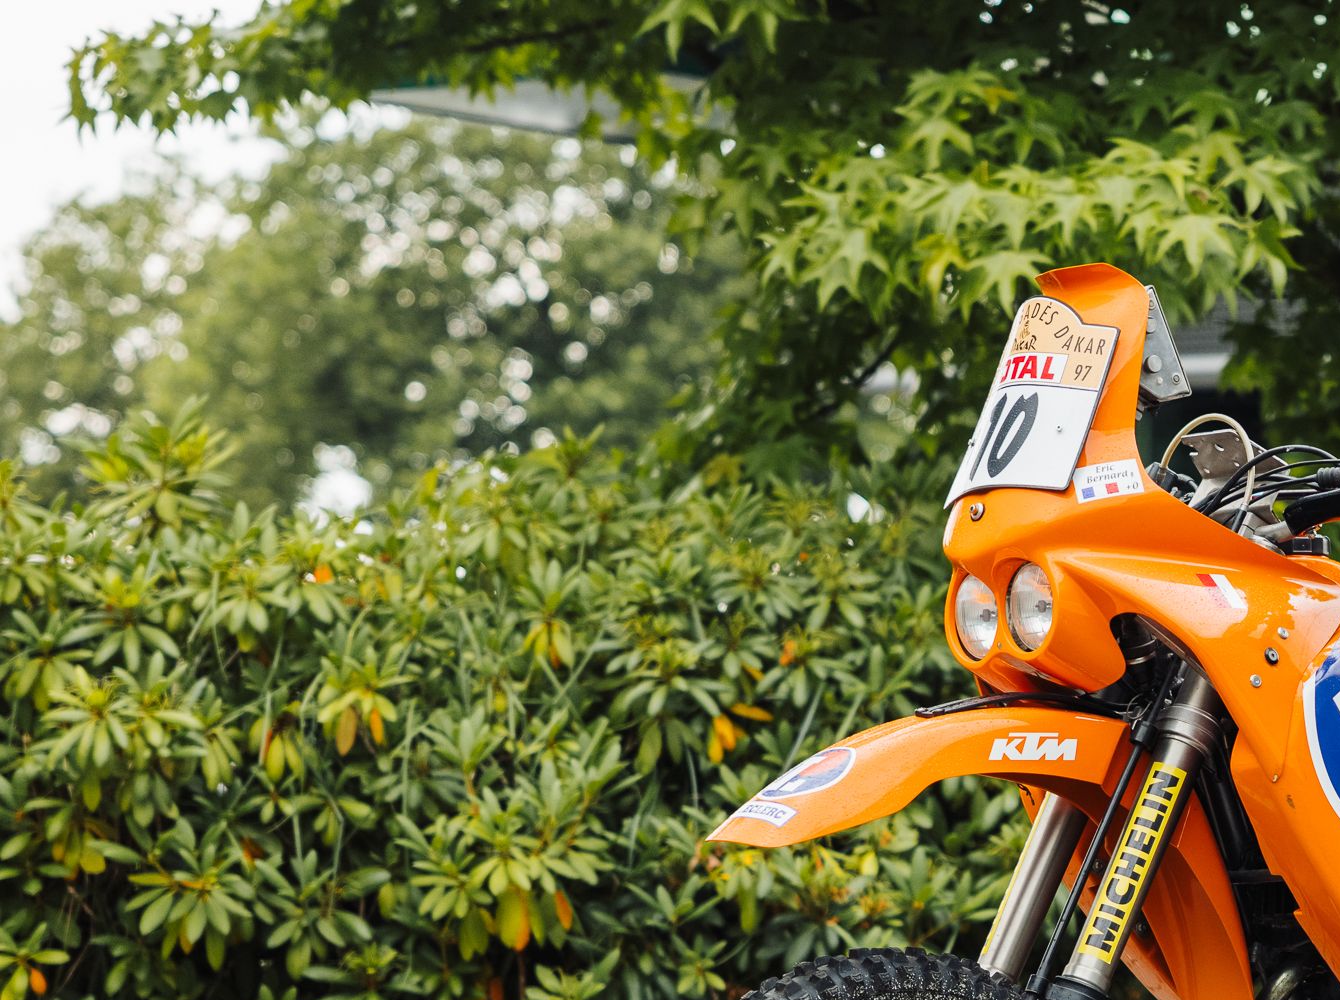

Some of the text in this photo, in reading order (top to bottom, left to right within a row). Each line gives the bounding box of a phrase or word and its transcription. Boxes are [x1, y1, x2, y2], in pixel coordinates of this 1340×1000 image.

[1074, 364, 1093, 382] 97
[969, 392, 1039, 482] 10
[1087, 470, 1128, 483] Bernard
[989, 732, 1078, 761] KTM
[743, 803, 787, 820] ECLERC
[1085, 770, 1180, 953] MICHELIN
